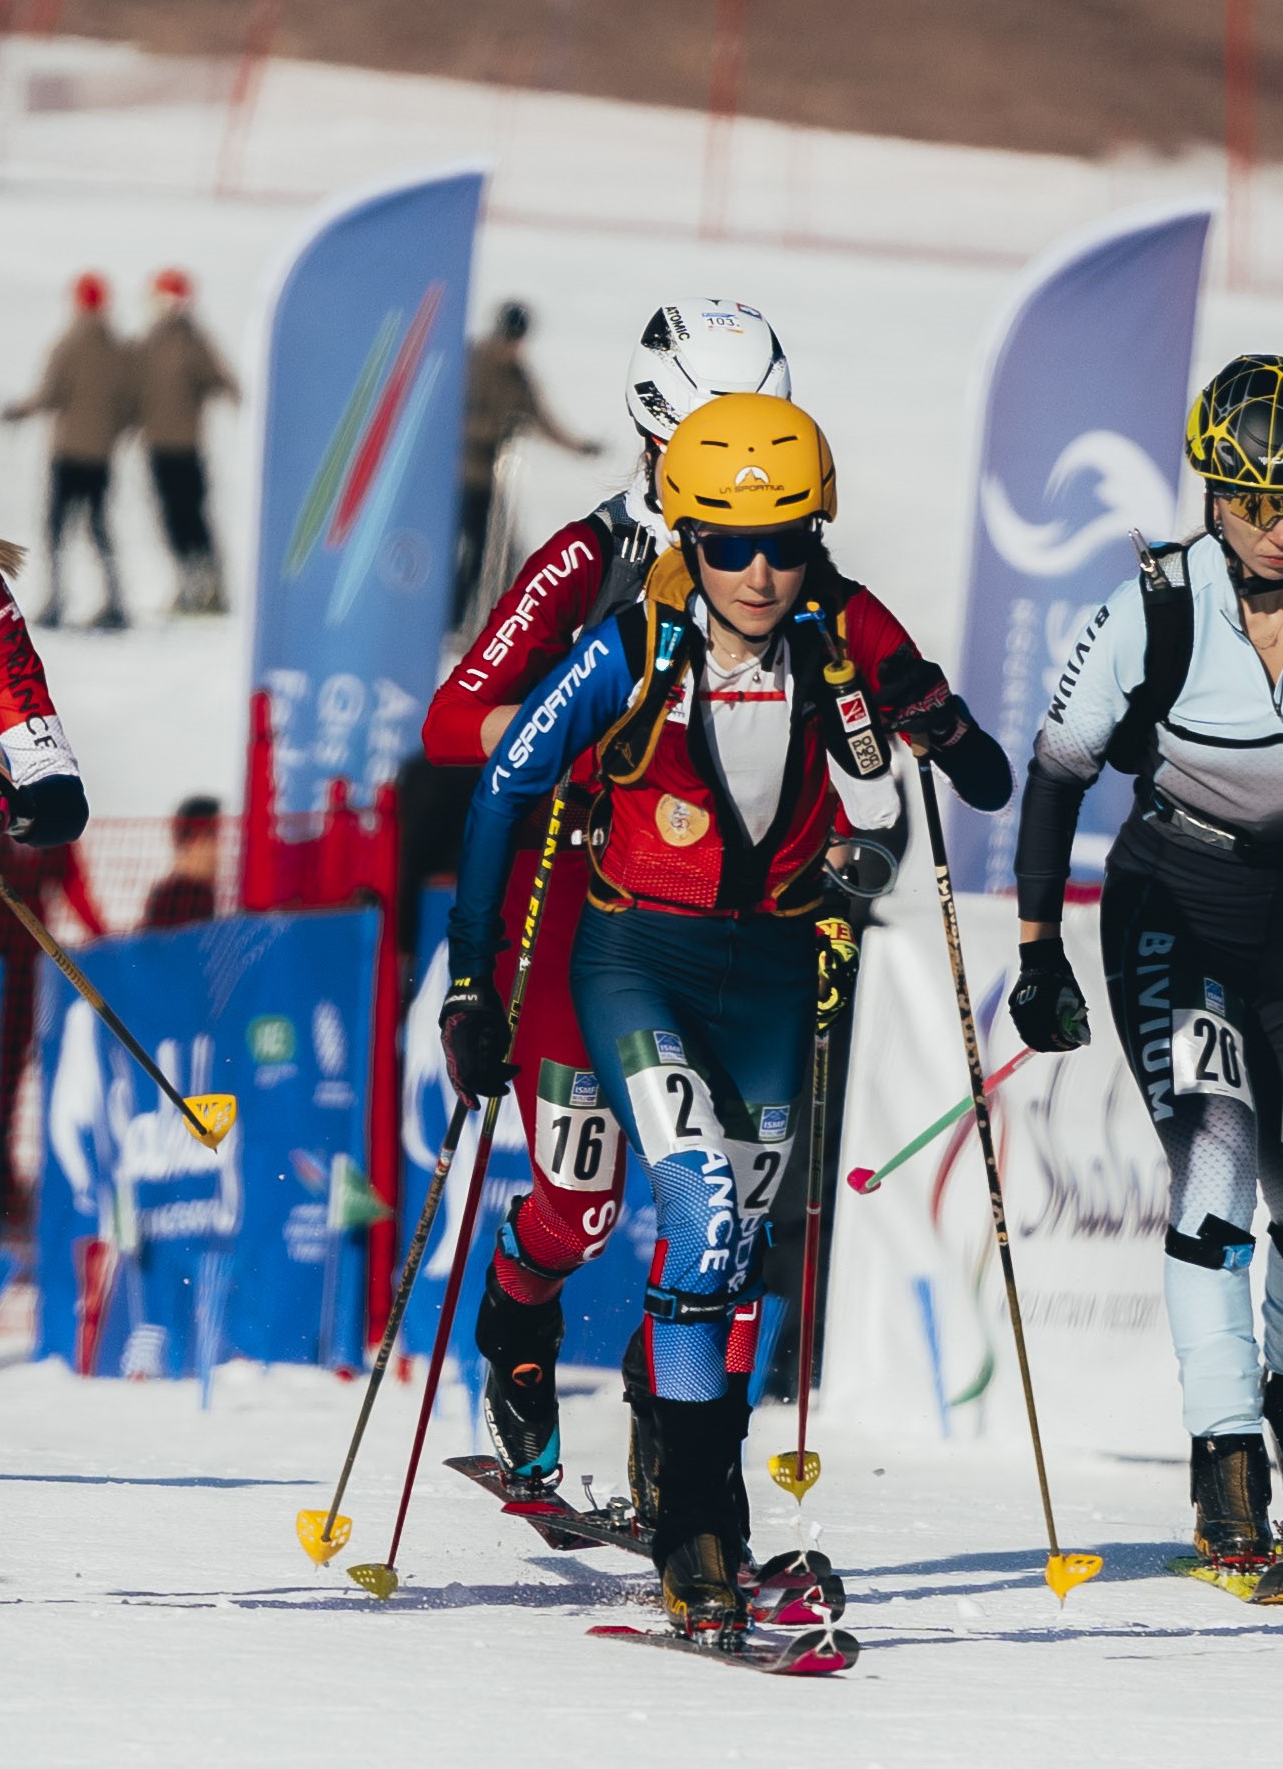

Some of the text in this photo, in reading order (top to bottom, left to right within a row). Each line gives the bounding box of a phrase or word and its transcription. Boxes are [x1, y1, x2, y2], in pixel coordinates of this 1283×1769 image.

[665, 306, 690, 341] ATOMIC
[2, 629, 58, 750] FRANCE
[1048, 605, 1110, 725] BIVIUM
[508, 639, 609, 769] SPORTIVA
[543, 799, 565, 870] LEKI
[1137, 931, 1176, 1122] BIVIUM
[1193, 1017, 1242, 1089] 20
[665, 1072, 703, 1138] 2
[551, 1114, 606, 1181] 16
[743, 1150, 782, 1210] 2
[699, 1150, 734, 1274] ANCE
[484, 1396, 515, 1470] SCARPA
